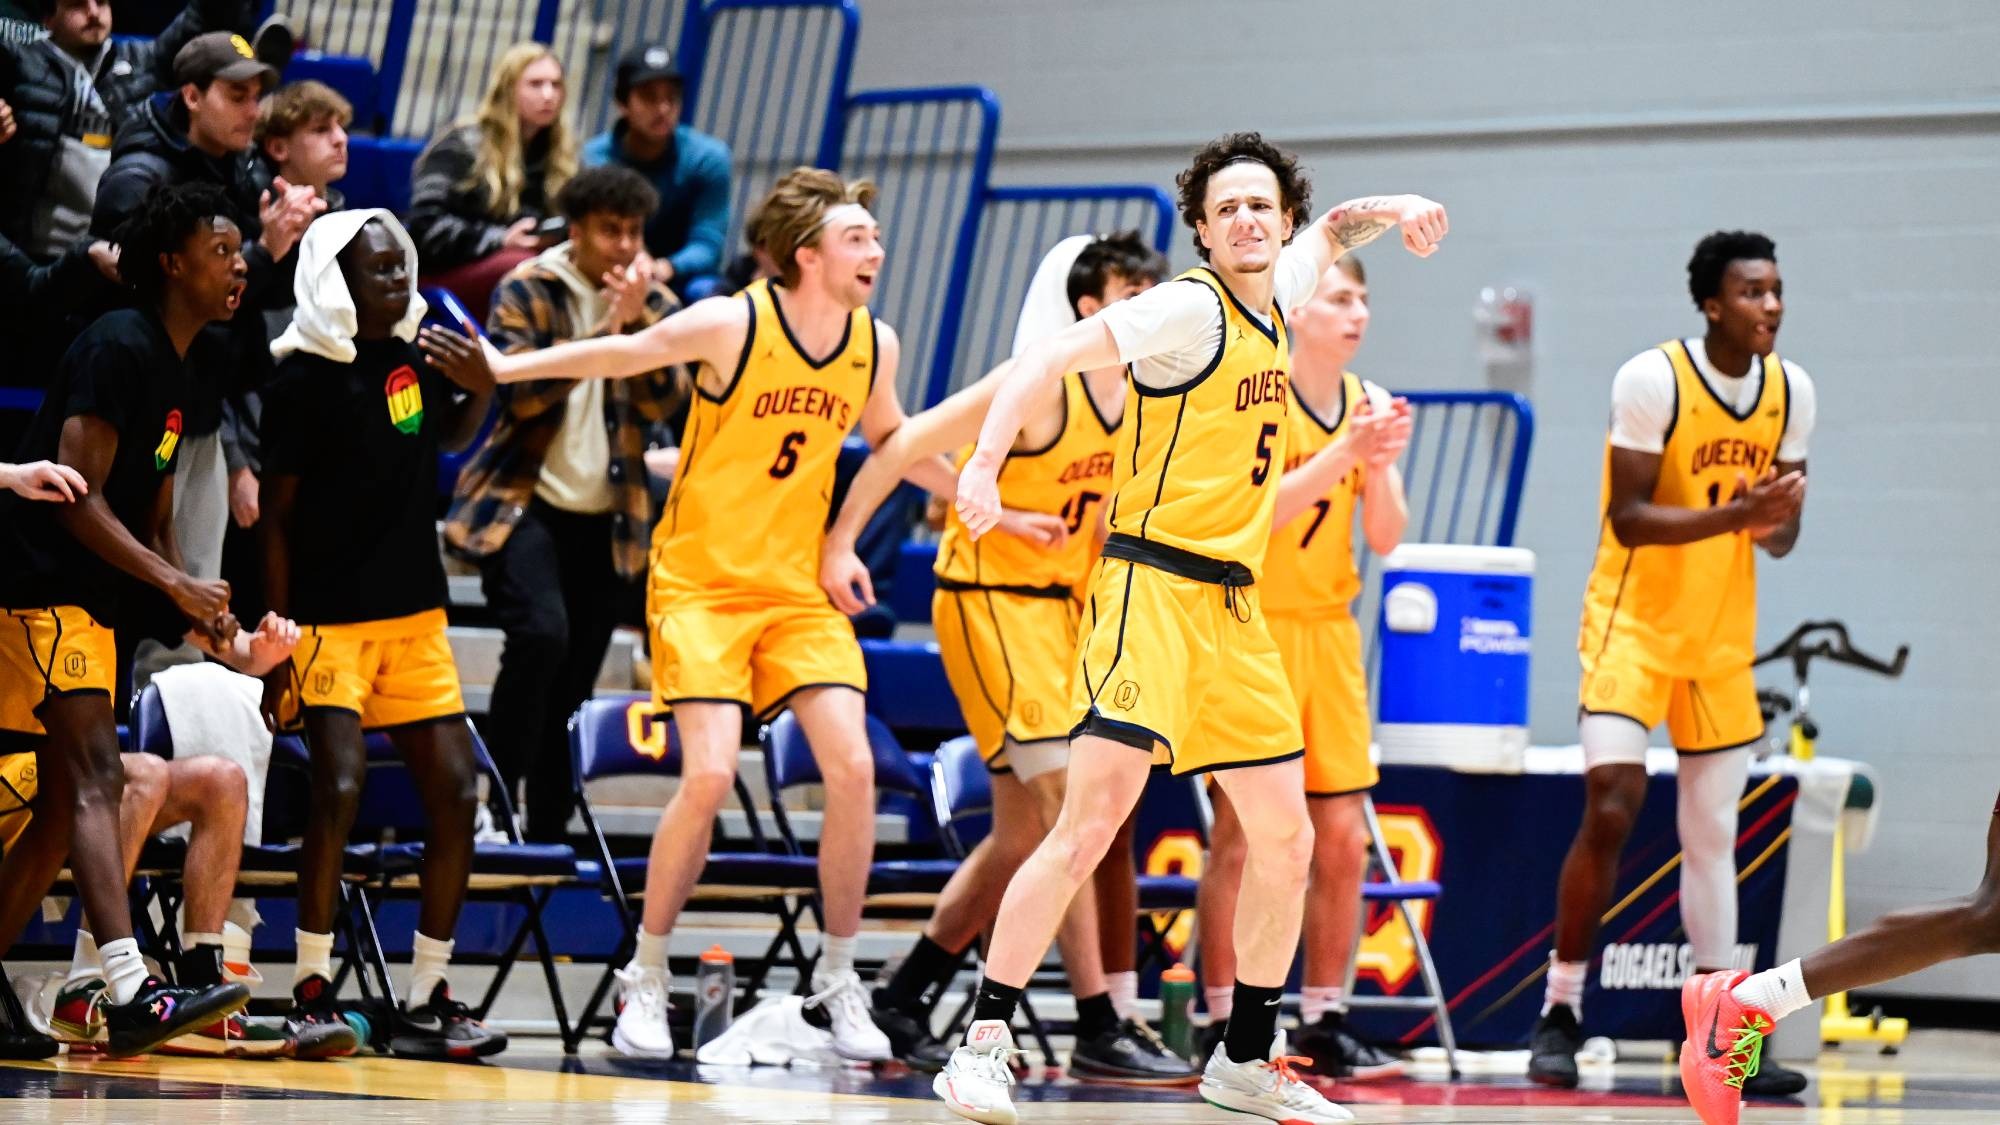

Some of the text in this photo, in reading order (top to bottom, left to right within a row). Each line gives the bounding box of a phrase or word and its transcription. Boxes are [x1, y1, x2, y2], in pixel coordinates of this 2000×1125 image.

[752, 386, 851, 431] QUEEN'S
[768, 430, 807, 480] 6
[1251, 422, 1279, 487] 5
[1299, 498, 1331, 549] 7
